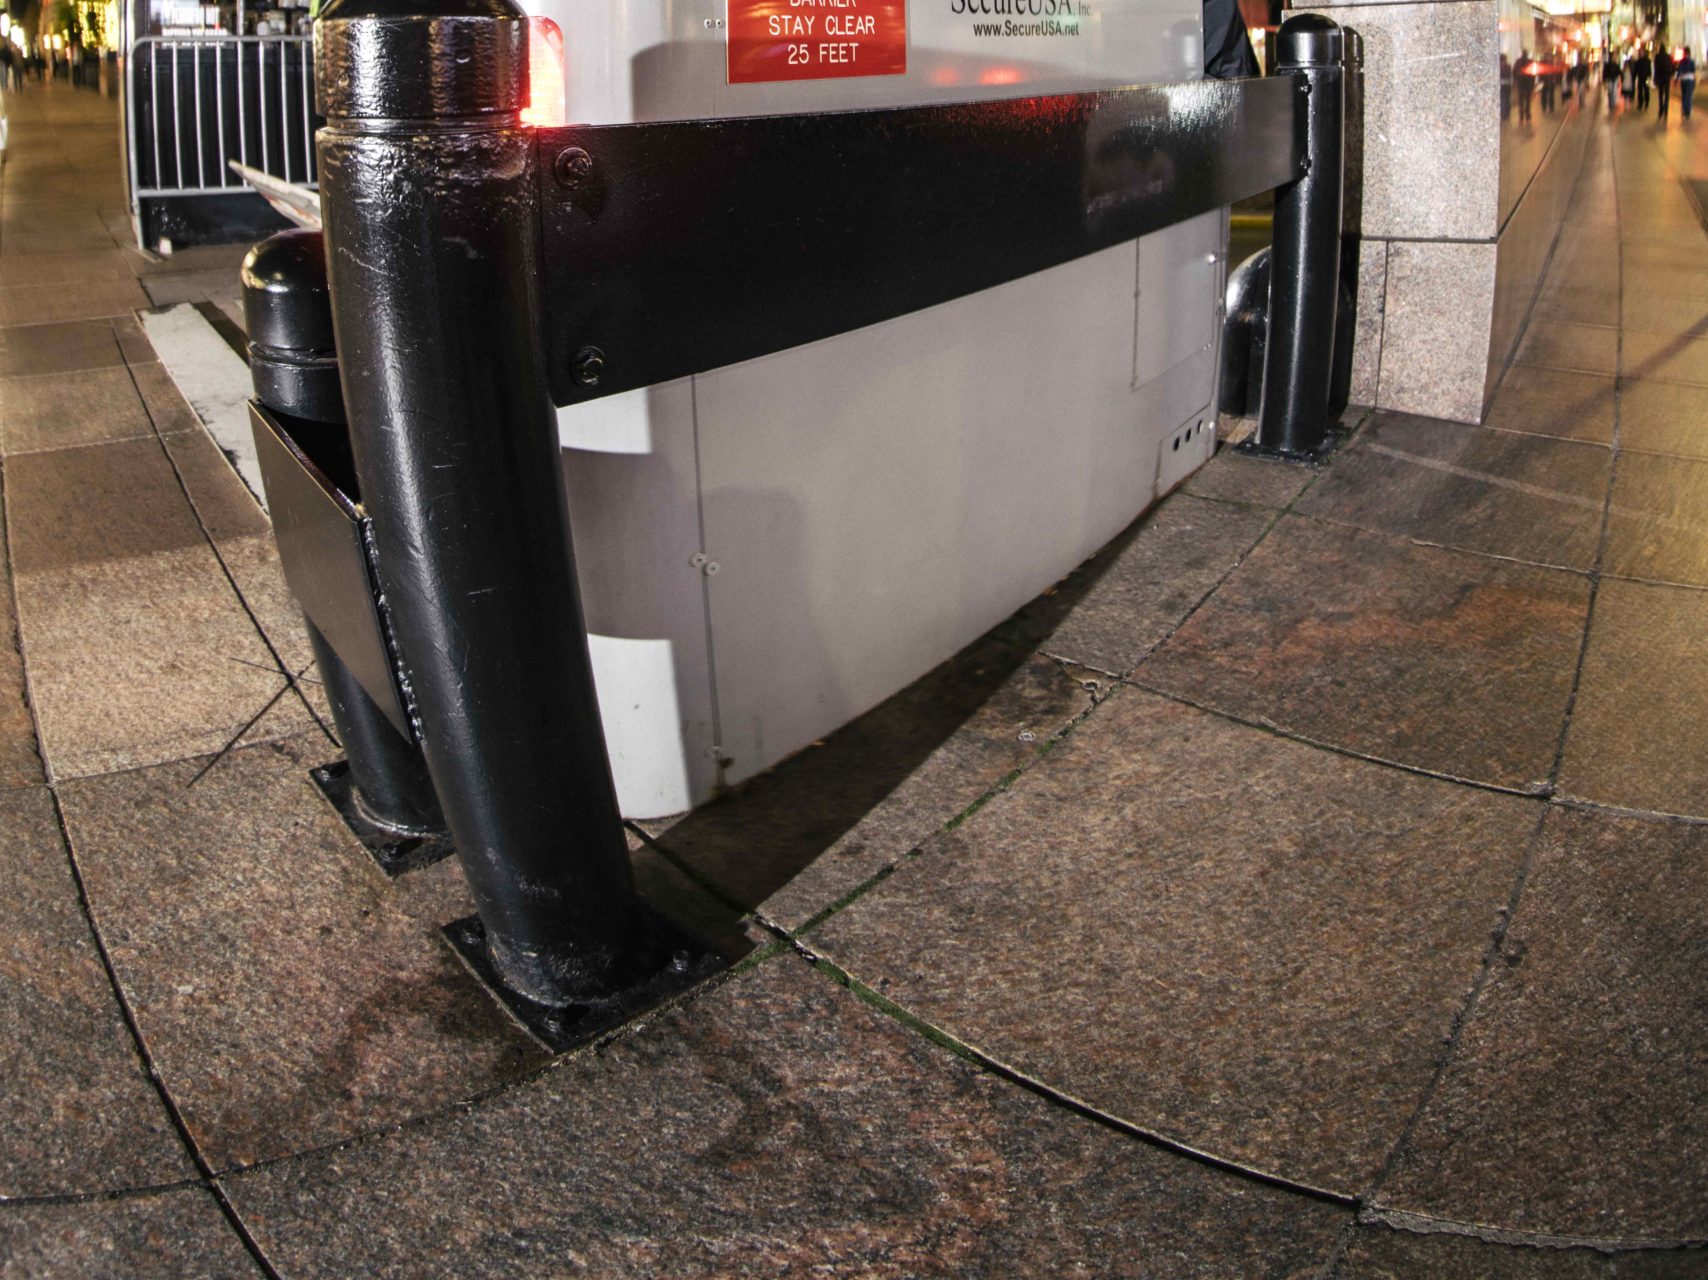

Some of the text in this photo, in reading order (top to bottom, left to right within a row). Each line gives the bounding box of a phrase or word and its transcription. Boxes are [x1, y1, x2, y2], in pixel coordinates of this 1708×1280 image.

[769, 15, 875, 35] STAY CLEAR
[973, 19, 1079, 37] www.SecureUSA.net
[788, 43, 859, 64] 25 FEET
